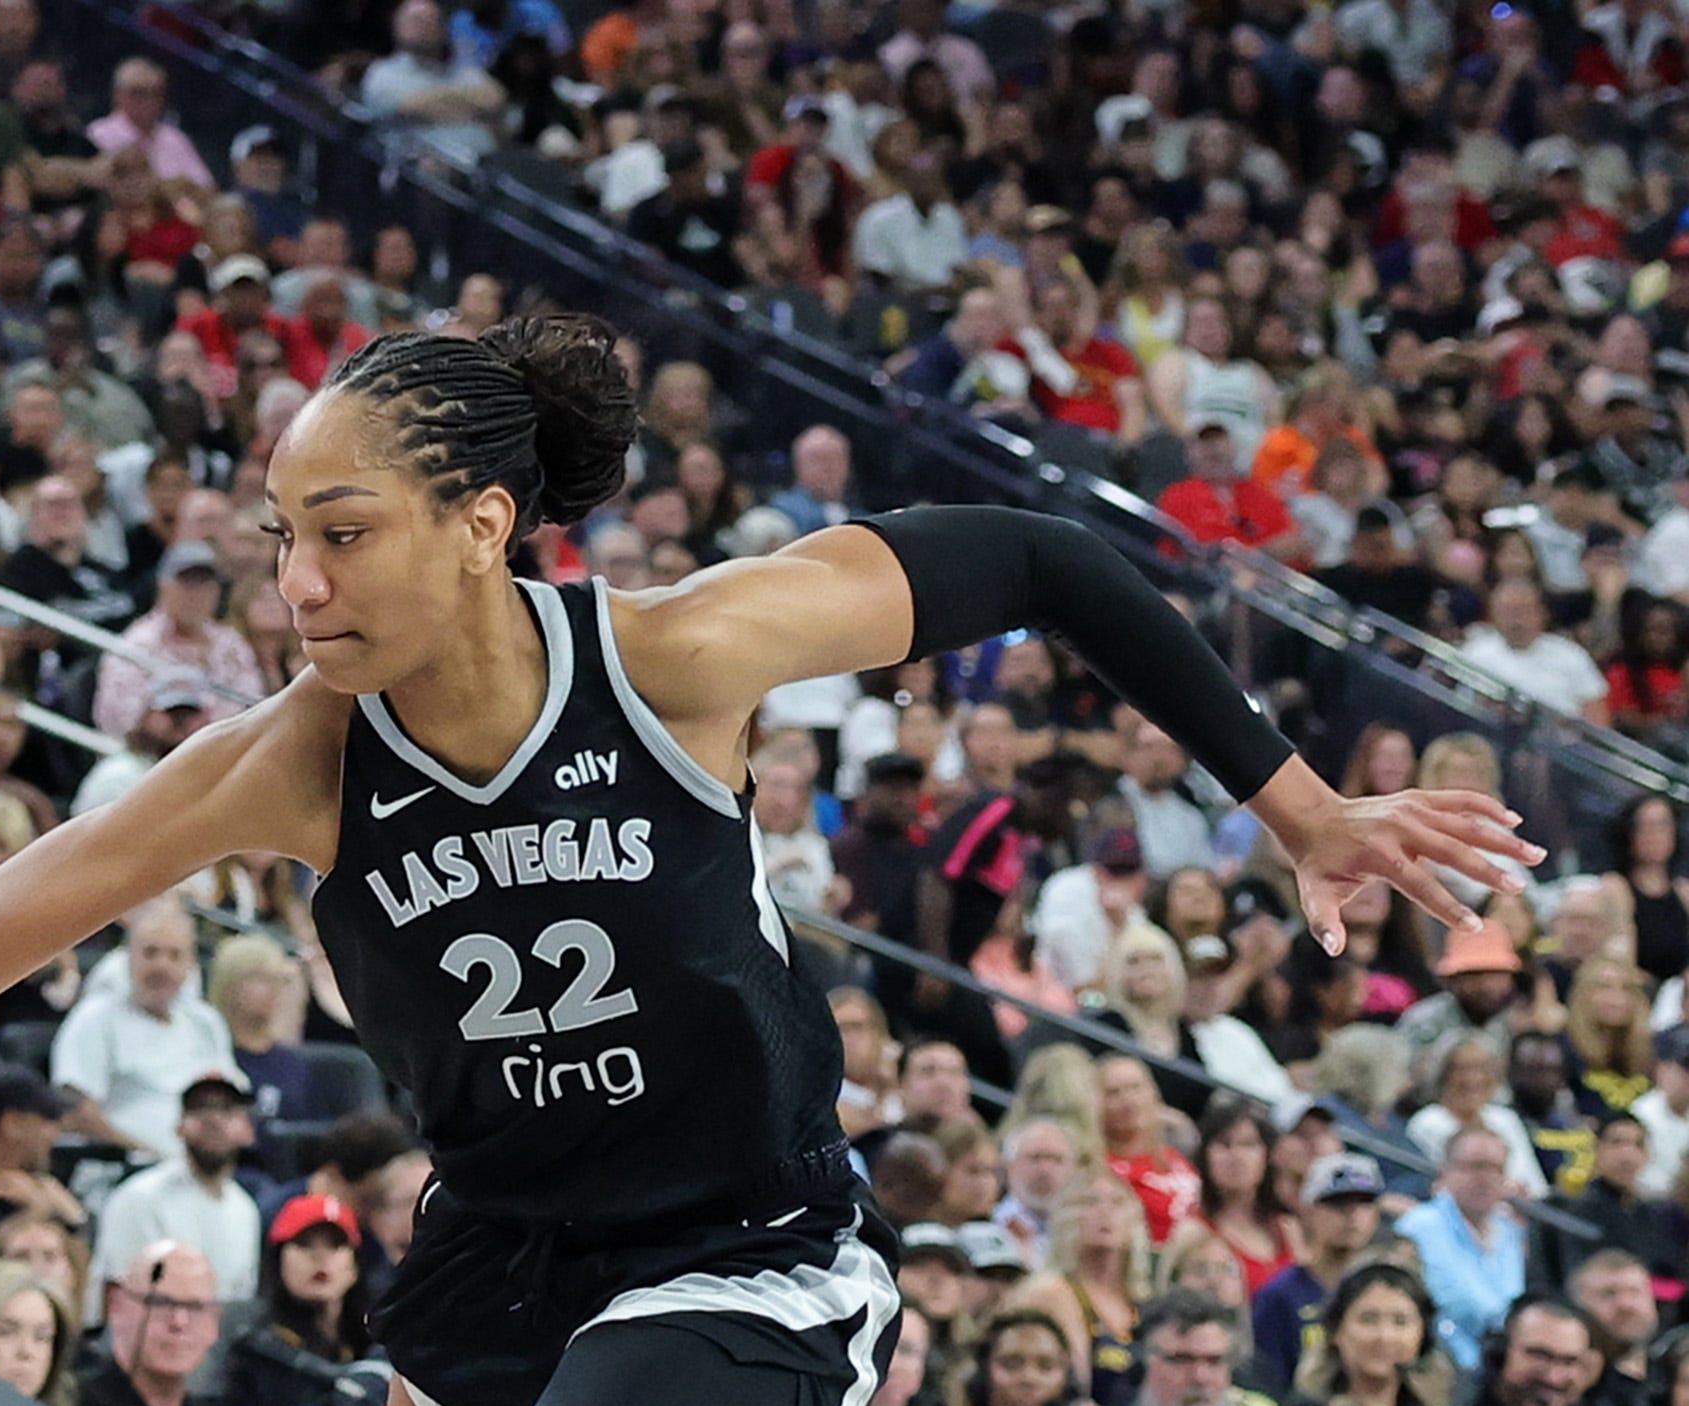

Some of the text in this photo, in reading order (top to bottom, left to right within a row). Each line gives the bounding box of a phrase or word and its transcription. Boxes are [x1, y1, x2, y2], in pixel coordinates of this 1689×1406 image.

[554, 749, 618, 790] ally
[365, 817, 654, 928] LAS VEGAS
[438, 918, 639, 1041] 22
[502, 1043, 645, 1107] ring
